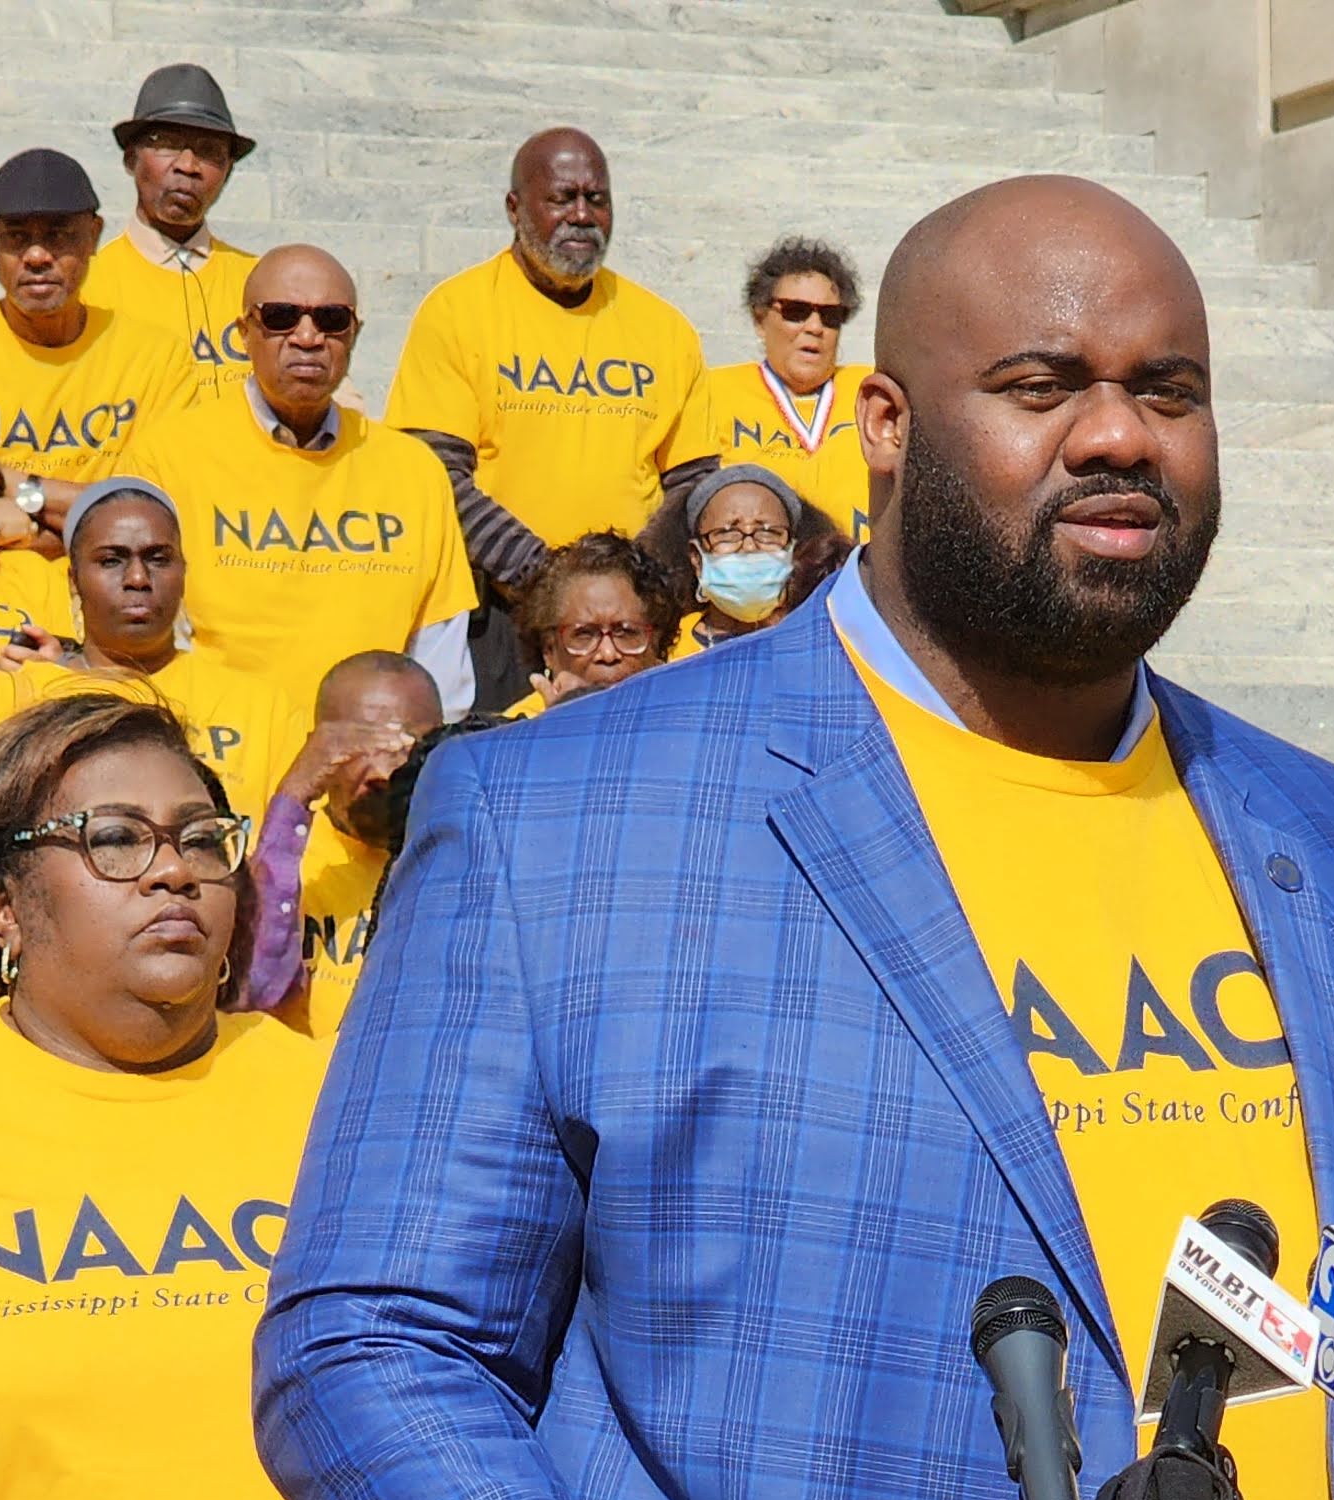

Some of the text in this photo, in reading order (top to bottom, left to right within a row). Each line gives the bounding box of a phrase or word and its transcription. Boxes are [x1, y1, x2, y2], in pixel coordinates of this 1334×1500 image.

[497, 354, 655, 398] NAACP
[213, 503, 404, 553] NAACP
[215, 553, 415, 575] Mississippi State Conference
[1011, 948, 1292, 1076] AAC
[1122, 1091, 1206, 1125] State
[1178, 1260, 1251, 1322] ON YOUR SIDE
[1182, 1237, 1265, 1309] WLBT
[152, 1287, 230, 1309] State
